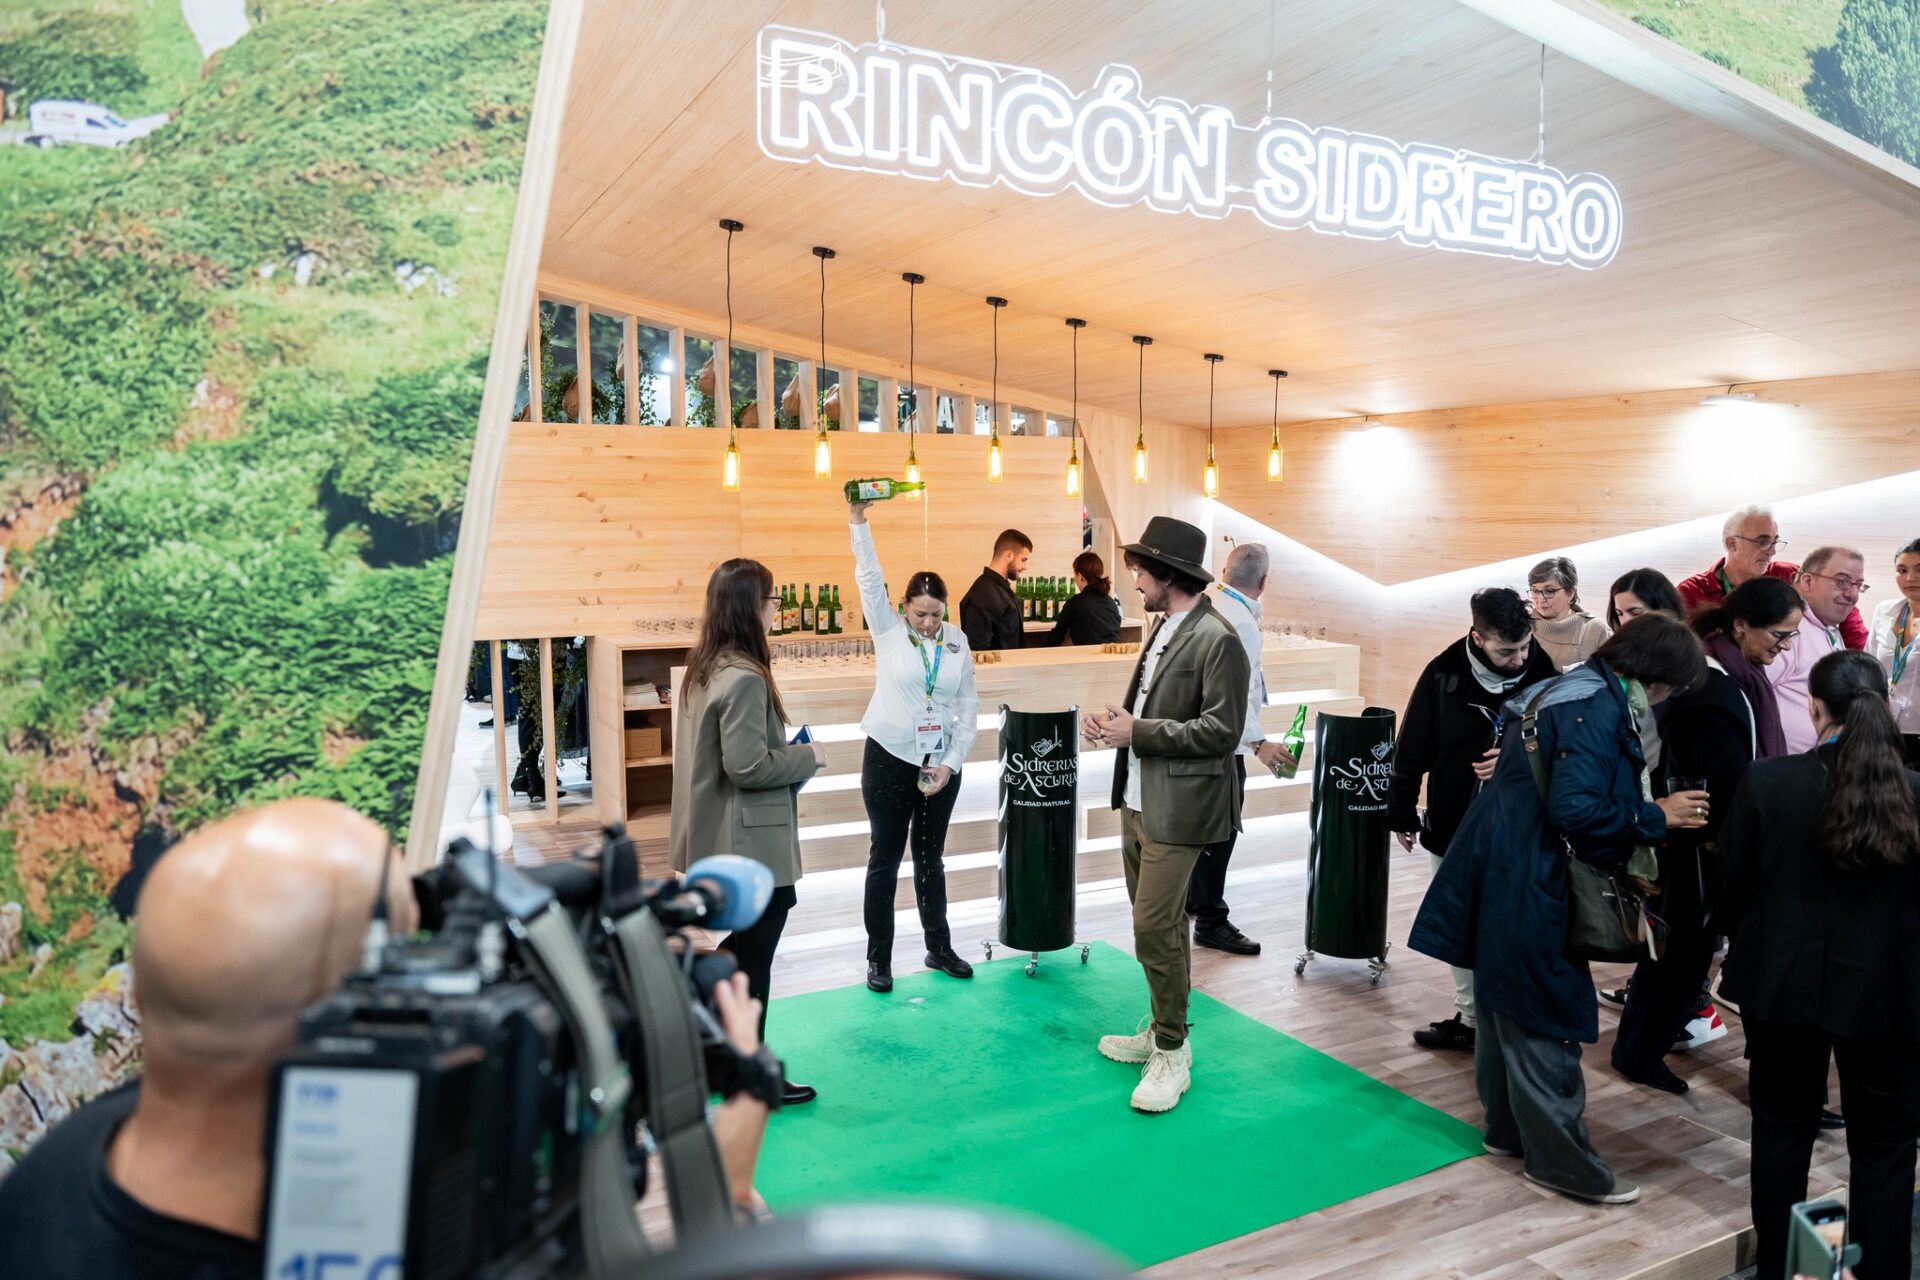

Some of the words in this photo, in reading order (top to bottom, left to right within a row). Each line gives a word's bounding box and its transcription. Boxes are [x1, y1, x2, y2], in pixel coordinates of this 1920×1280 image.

[768, 36, 1229, 208] RINCÓN
[1255, 127, 1619, 262] SIDRERO
[1329, 757, 1392, 779] SIDRE
[1018, 771, 1078, 798] ASTURIA
[1012, 799, 1042, 807] CALIDAD
[1042, 799, 1071, 807] NATURAL
